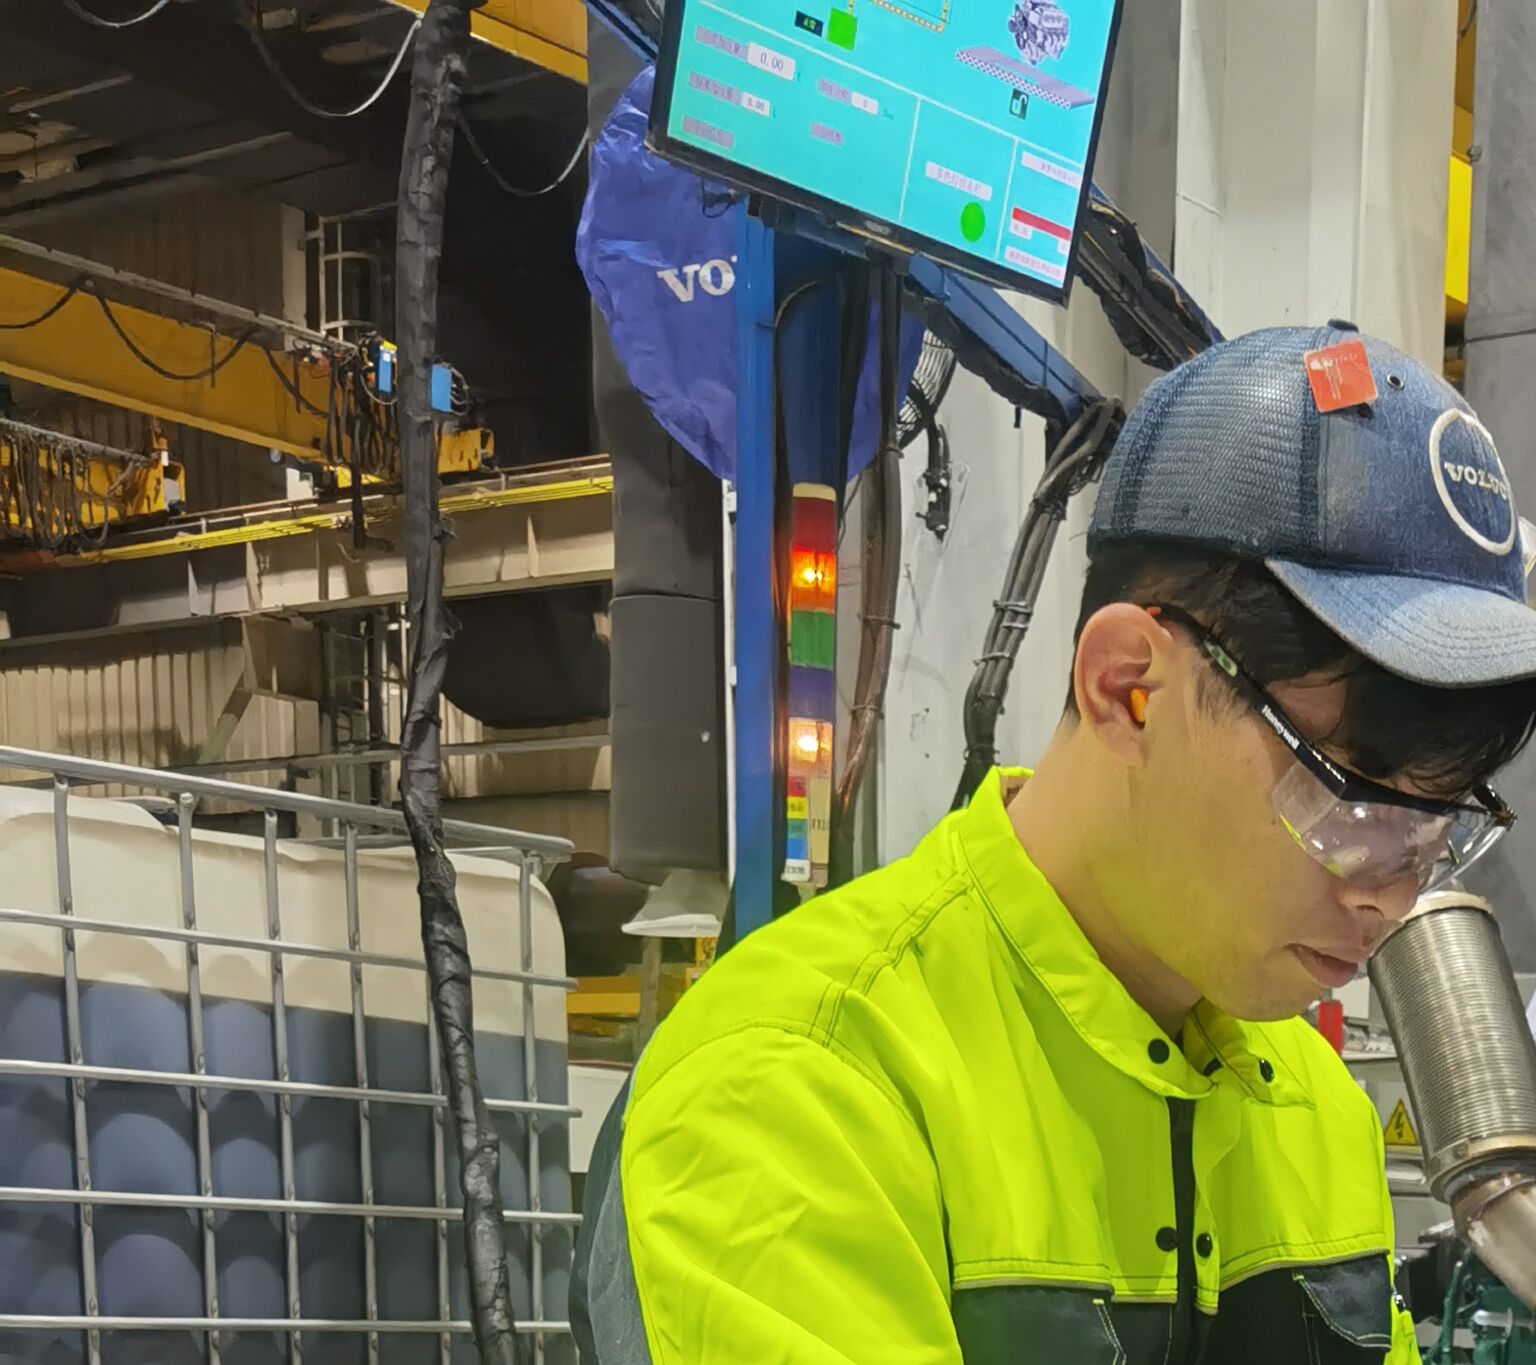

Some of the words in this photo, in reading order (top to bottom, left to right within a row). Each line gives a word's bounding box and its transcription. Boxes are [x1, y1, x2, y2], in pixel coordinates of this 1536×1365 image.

[759, 51, 785, 72] 0.00
[656, 255, 738, 303] VO
[1443, 461, 1508, 500] VOLVO
